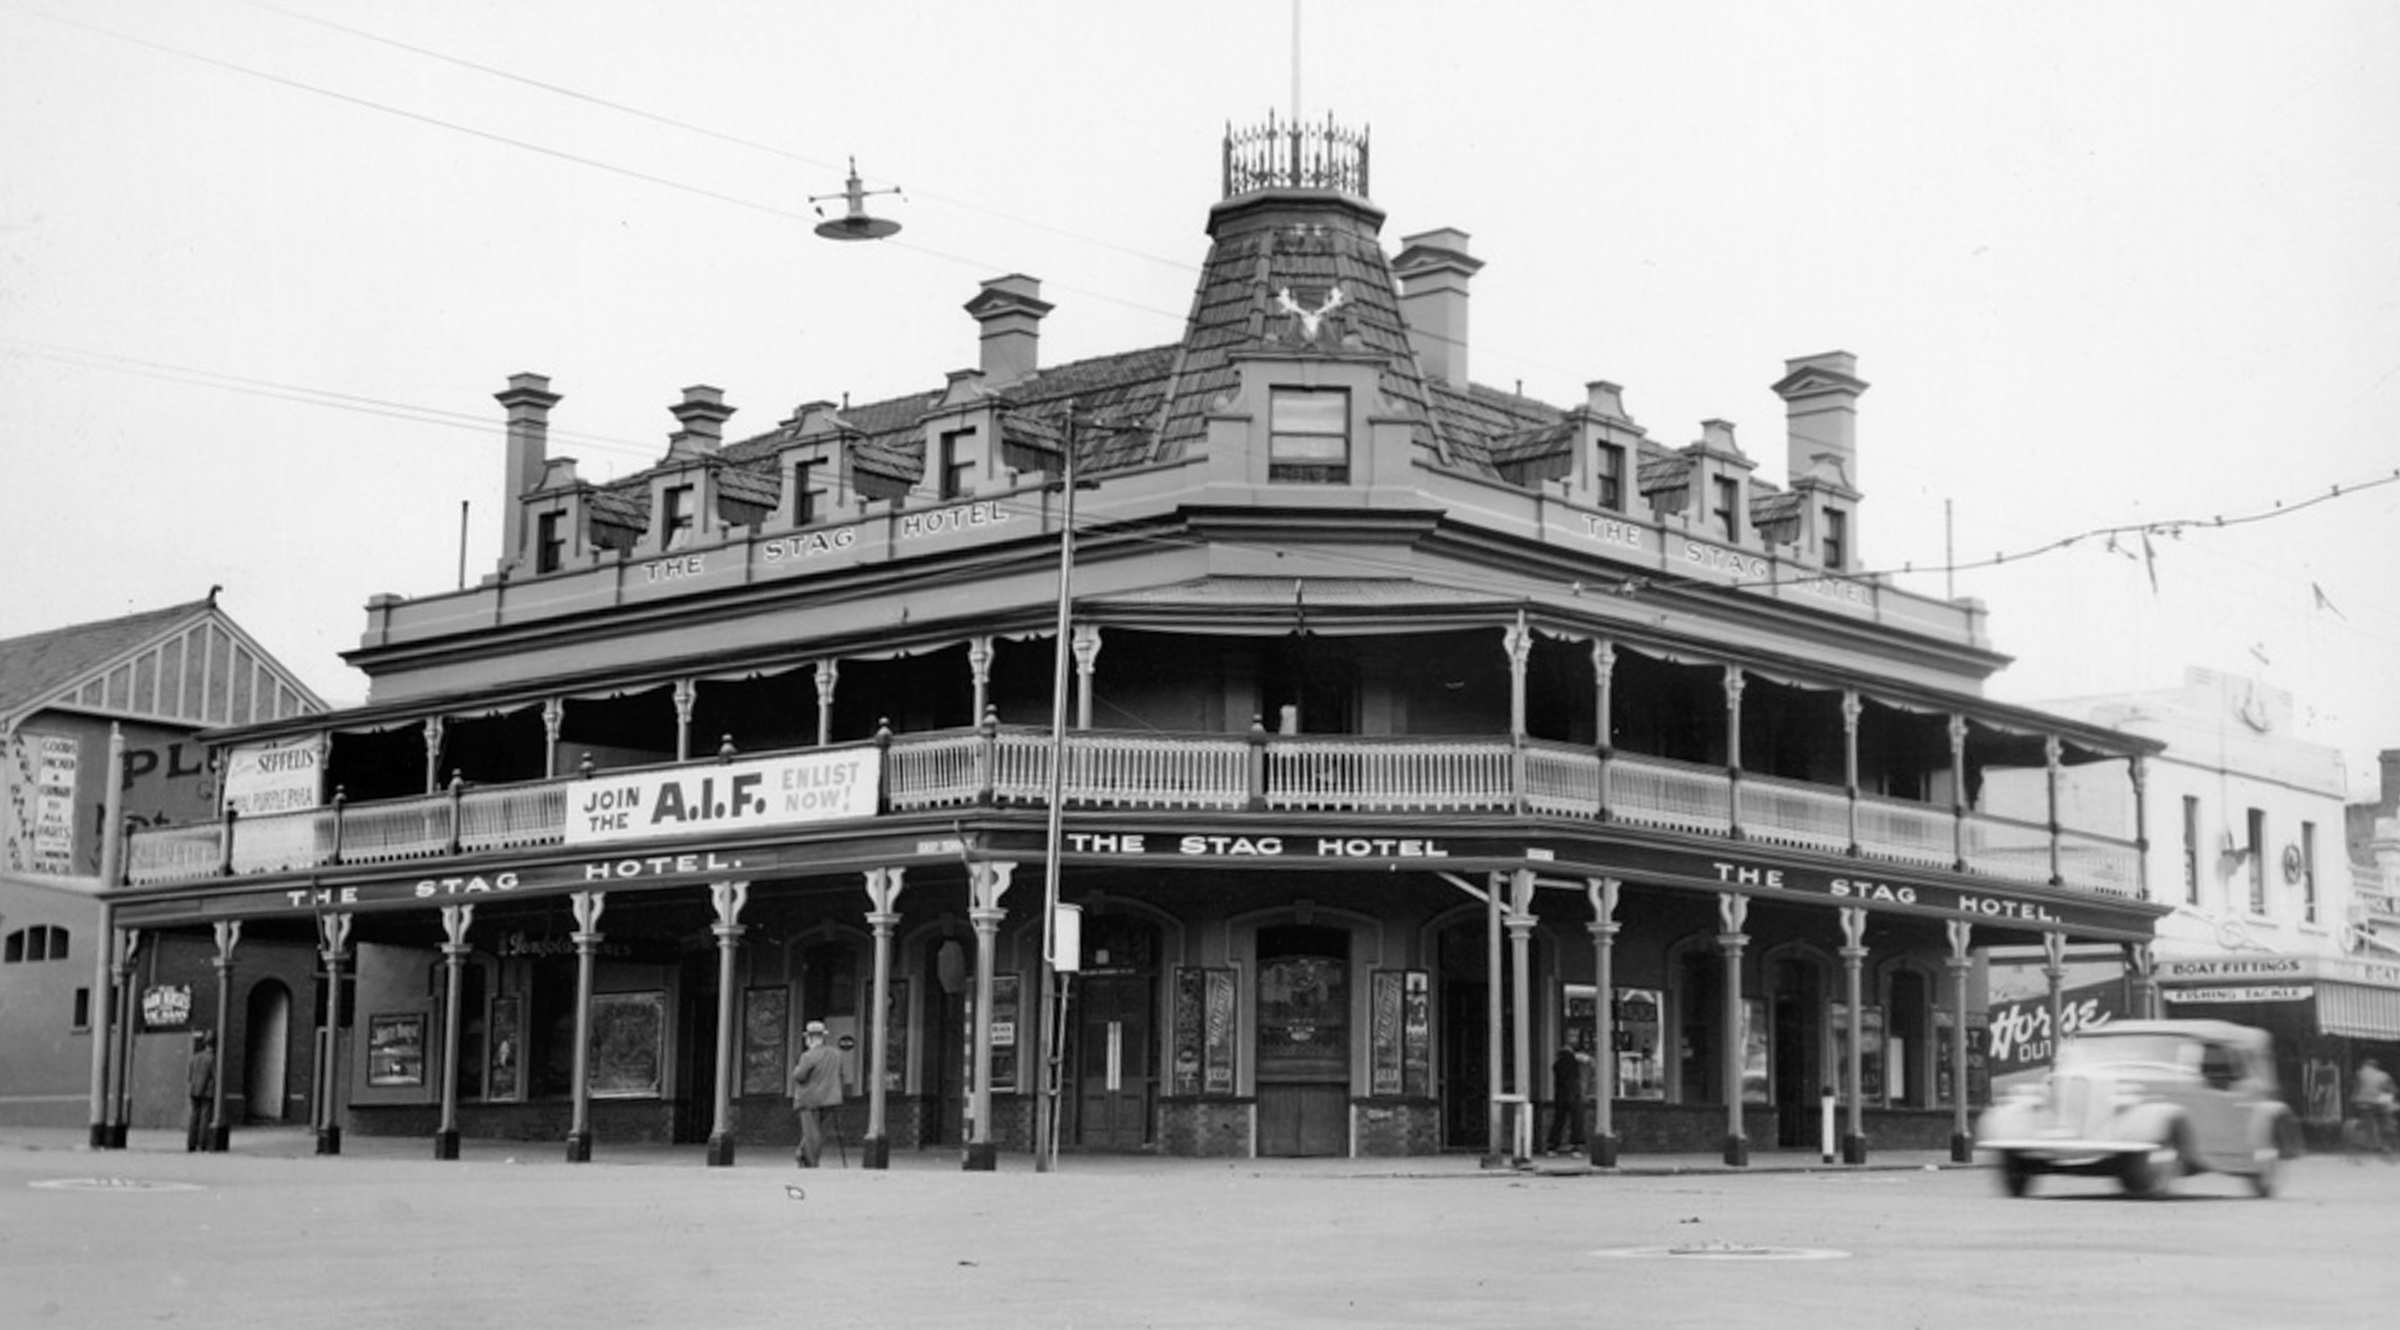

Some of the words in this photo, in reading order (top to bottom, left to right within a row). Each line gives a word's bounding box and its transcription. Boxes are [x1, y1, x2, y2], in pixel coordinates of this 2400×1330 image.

[645, 554, 704, 581] THE
[763, 528, 857, 561] STAG
[902, 501, 1008, 538] HOTEL
[1583, 513, 1641, 547] THE
[1686, 542, 1768, 578] STAG
[781, 762, 860, 790] ENLIST
[583, 786, 640, 813] JOIN
[650, 772, 766, 825] A.I.F.
[785, 786, 852, 813] NOW!
[588, 813, 629, 832] THE
[1067, 834, 1145, 853] THE
[1179, 836, 1283, 855] STAG
[1318, 838, 1448, 857] HOTEL
[287, 888, 358, 906] THE
[414, 873, 519, 898] STAG
[585, 854, 743, 880] HOTEL.
[1713, 862, 1784, 888] THE
[1830, 879, 1917, 904] STAG
[2173, 962, 2217, 975] BOAT
[2222, 960, 2301, 973] FITTINGS
